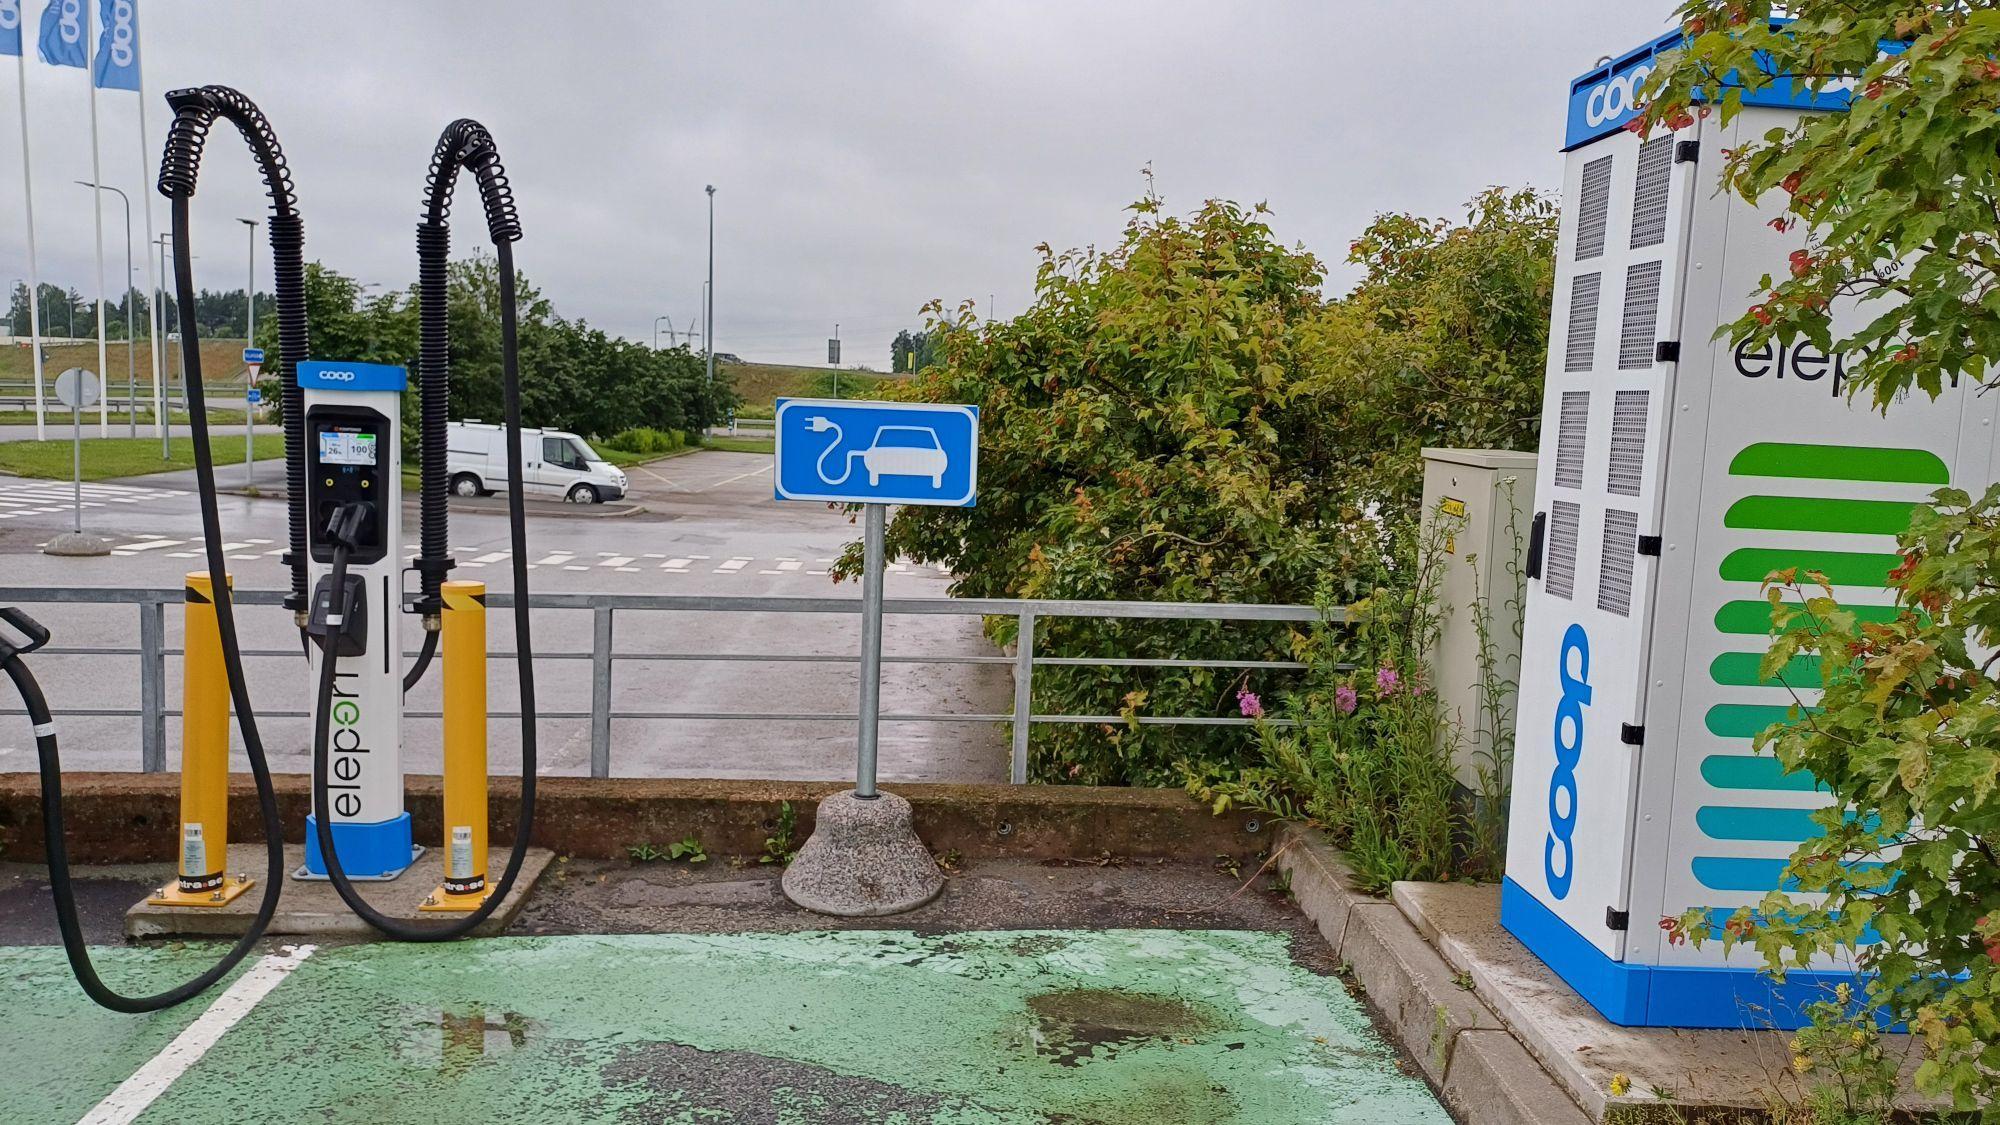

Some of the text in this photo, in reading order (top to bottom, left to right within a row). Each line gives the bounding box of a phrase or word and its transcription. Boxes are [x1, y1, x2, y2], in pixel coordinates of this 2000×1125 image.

[111, 0, 133, 67] coo
[1586, 65, 1671, 128] coo
[319, 370, 355, 382] coop
[1545, 623, 1592, 900] coop
